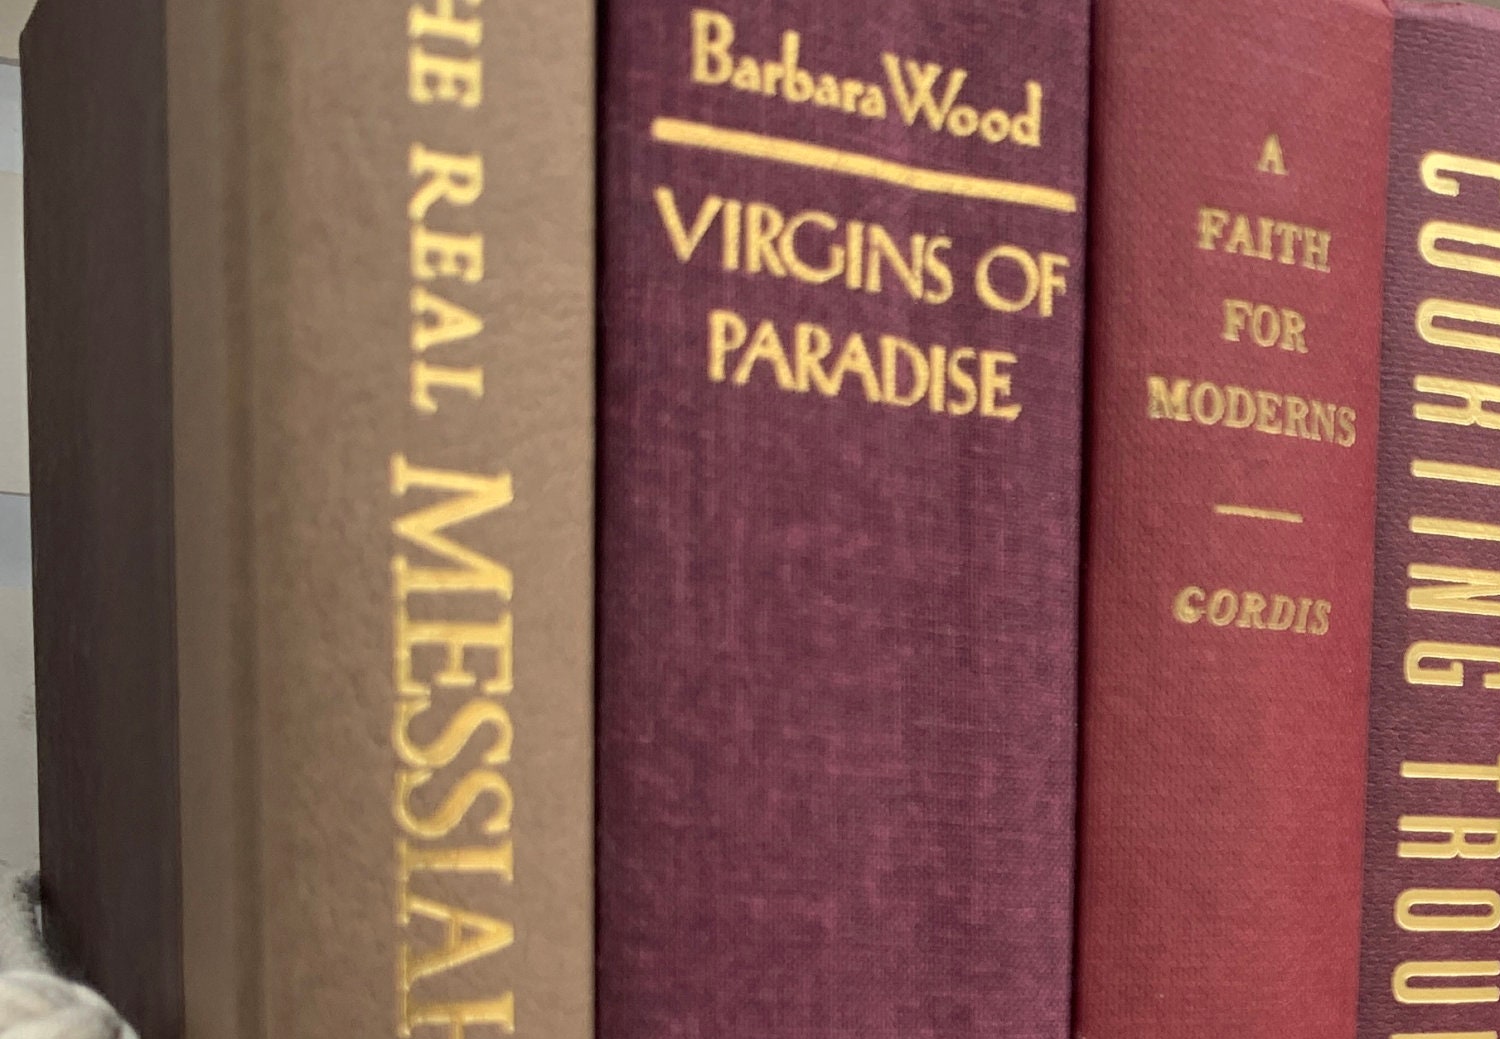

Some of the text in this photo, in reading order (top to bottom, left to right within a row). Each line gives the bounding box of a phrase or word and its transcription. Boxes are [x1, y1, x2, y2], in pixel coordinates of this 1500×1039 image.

[408, 0, 483, 107] HE
[690, 9, 1043, 148] Barbara Wood
[1256, 134, 1287, 176] A
[409, 143, 484, 414] REAL
[655, 186, 1069, 317] VIRGINS OF
[1197, 207, 1331, 273] FAITH
[708, 309, 1022, 421] PARADISE
[1222, 298, 1308, 353] FOR
[1146, 375, 1357, 448] MODERNS
[1174, 585, 1332, 636] CORDIS
